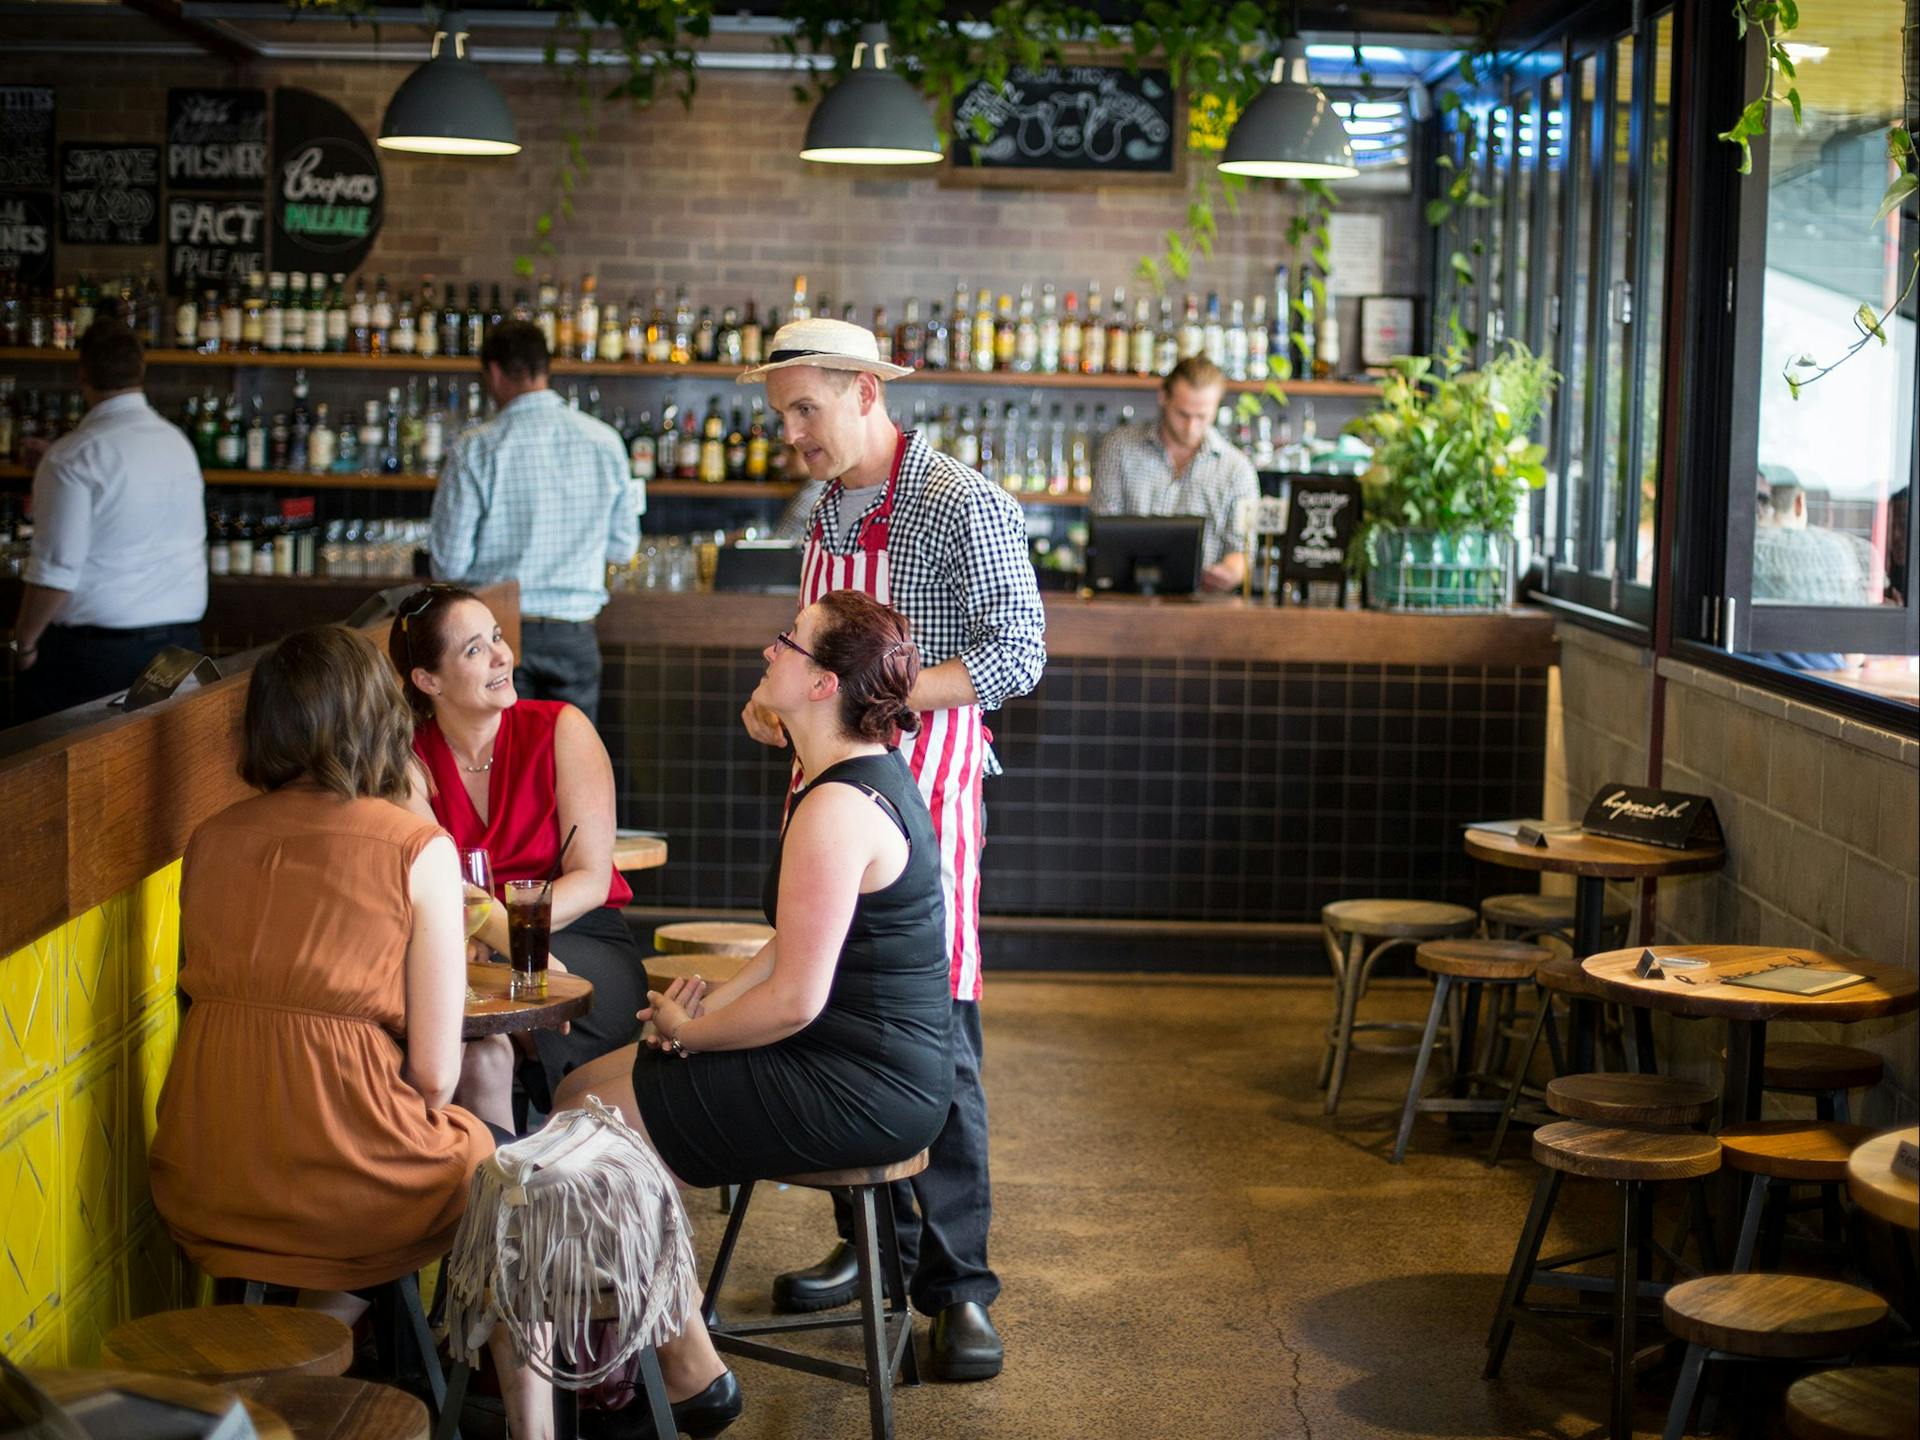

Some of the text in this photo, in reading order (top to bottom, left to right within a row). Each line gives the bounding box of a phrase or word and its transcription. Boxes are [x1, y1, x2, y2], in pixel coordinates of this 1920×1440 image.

[169, 144, 266, 177] PILSNER
[168, 201, 262, 243] PACT
[174, 249, 226, 277] PALE
